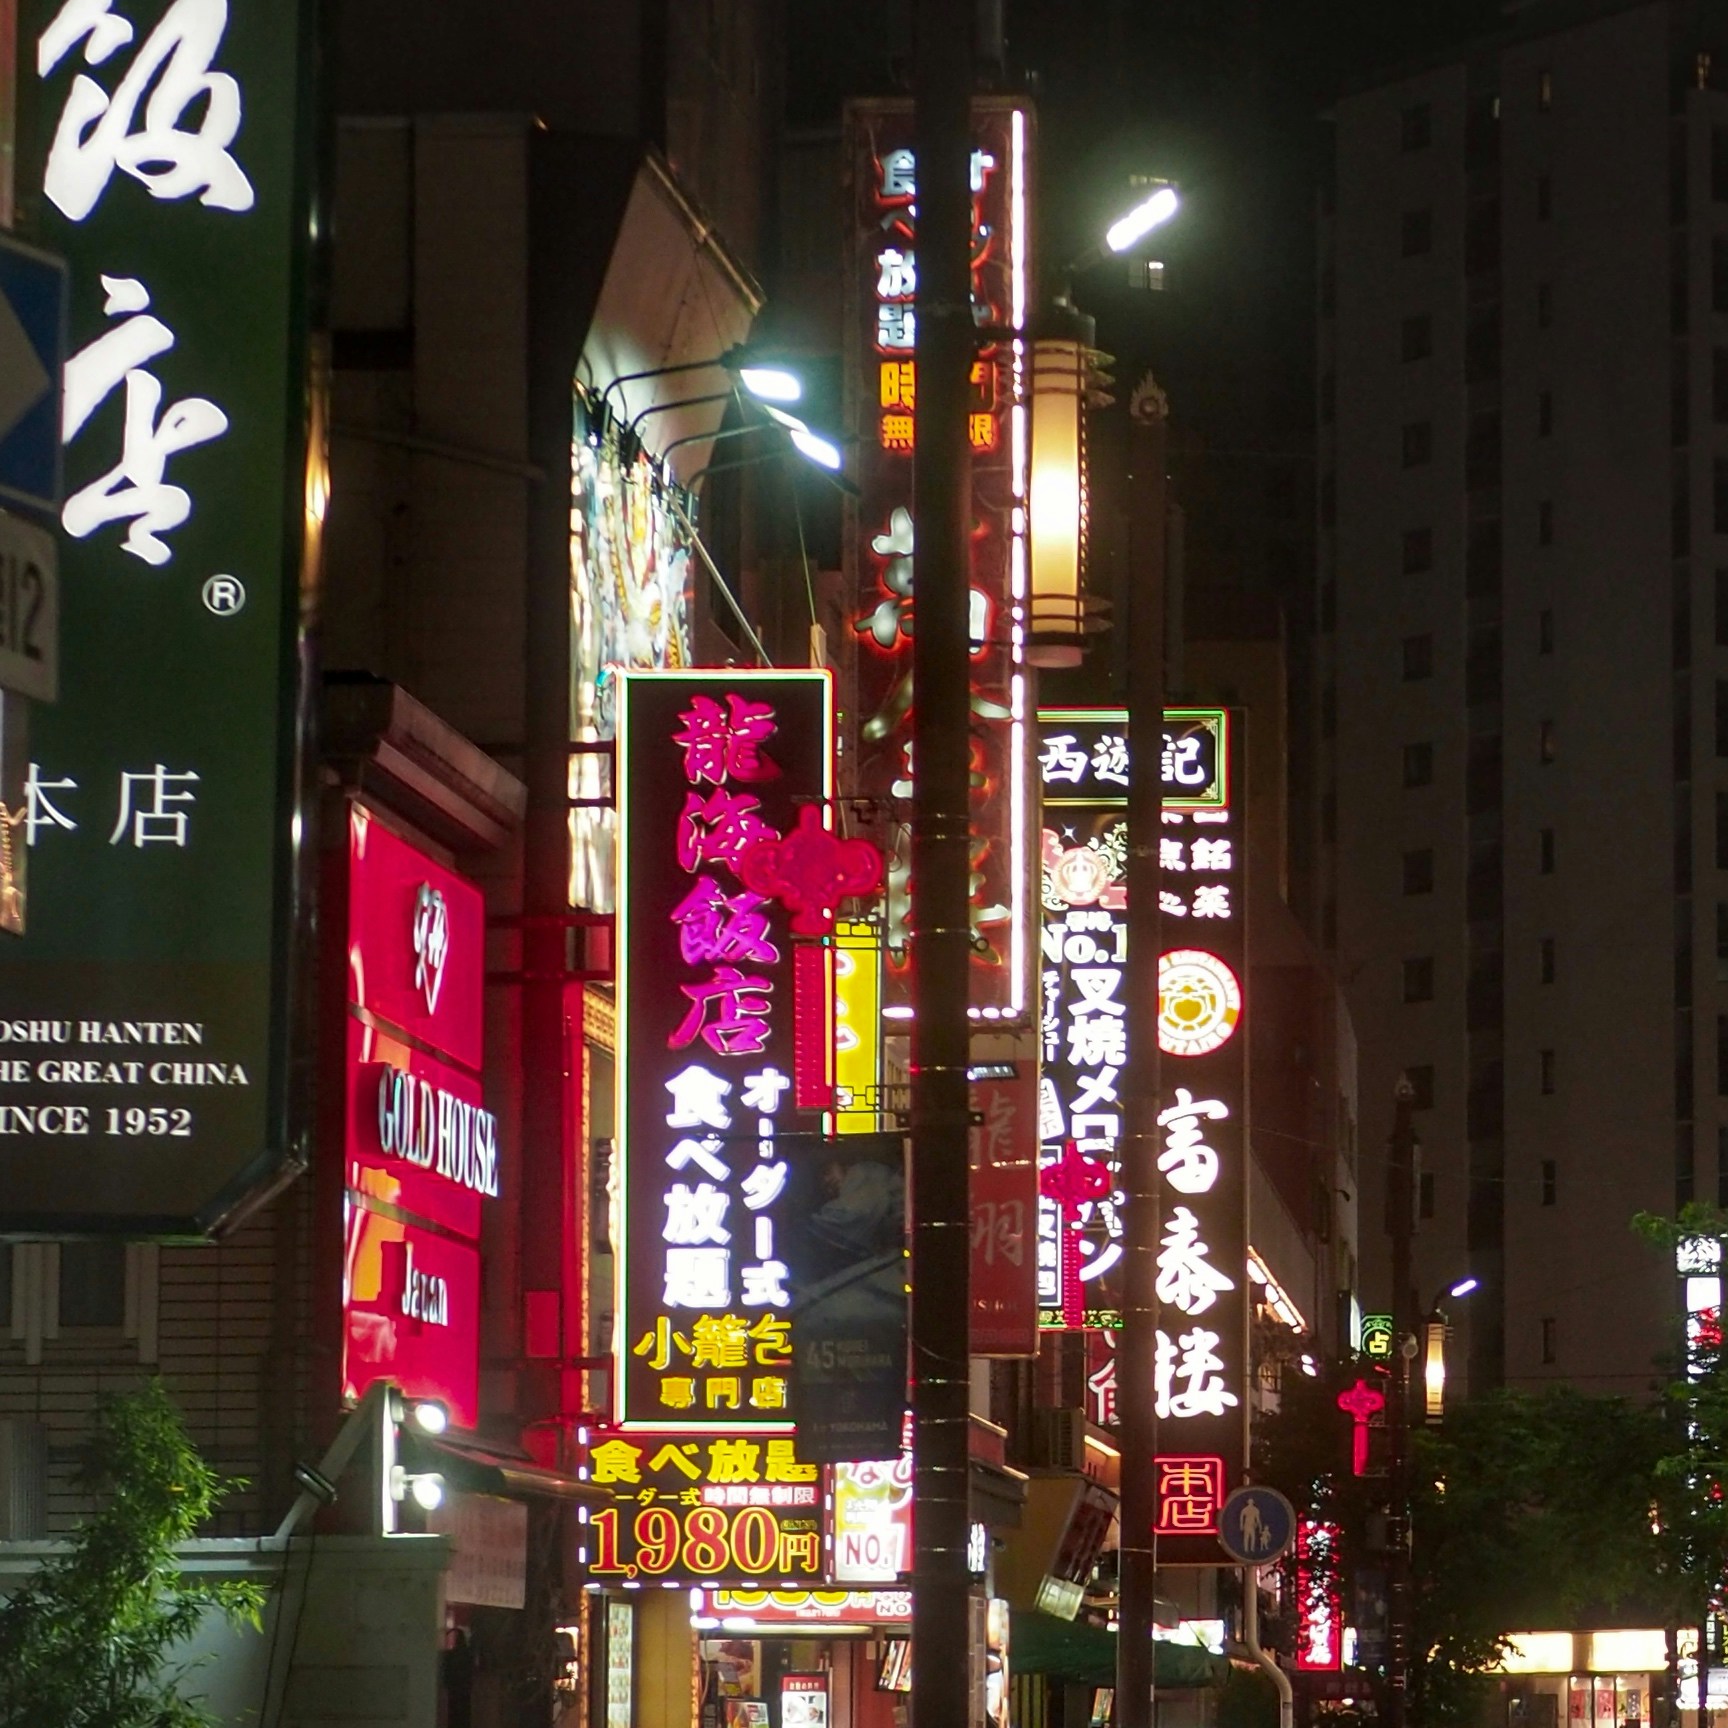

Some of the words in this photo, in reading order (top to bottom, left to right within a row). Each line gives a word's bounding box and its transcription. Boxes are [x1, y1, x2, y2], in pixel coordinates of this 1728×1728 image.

[1038, 733, 1205, 786] 西遊記
[667, 692, 780, 1056] 龍海飯店
[79, 1022, 204, 1046] HANTEN
[37, 1060, 144, 1084] GREAT
[150, 1063, 249, 1086] CHINA
[104, 1108, 192, 1137] 1952
[378, 1062, 435, 1170] GOLD
[436, 1088, 499, 1198] HOUSE
[662, 1065, 733, 1309] 食べ放題
[1160, 1462, 1214, 1529] 本店
[589, 1506, 820, 1580] 1,980円
